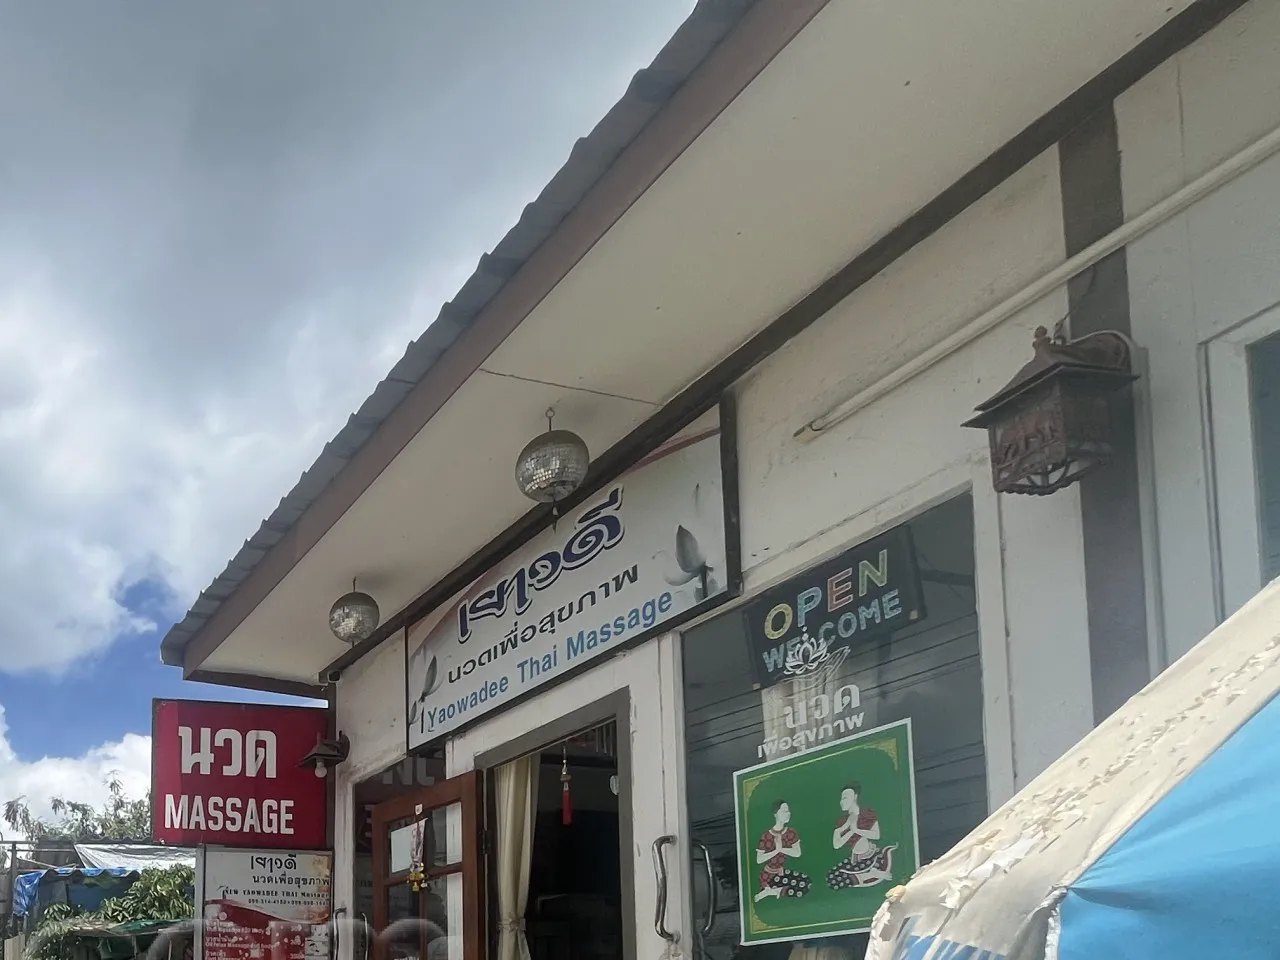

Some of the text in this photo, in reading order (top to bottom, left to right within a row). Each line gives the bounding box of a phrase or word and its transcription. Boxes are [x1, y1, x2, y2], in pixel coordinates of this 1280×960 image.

[764, 549, 888, 640] OPEN
[448, 564, 640, 684] นวดเพื่อสุขภาพ
[762, 589, 902, 673] WECOME
[427, 591, 672, 733] Yaowadee Thai Massage
[784, 684, 861, 729] นวด
[178, 726, 278, 779] นวด
[757, 711, 865, 759] เพื่อสุขภาพ
[164, 793, 294, 835] MASSAGE
[253, 871, 330, 888] นวดเพื่อสุขภาพ
